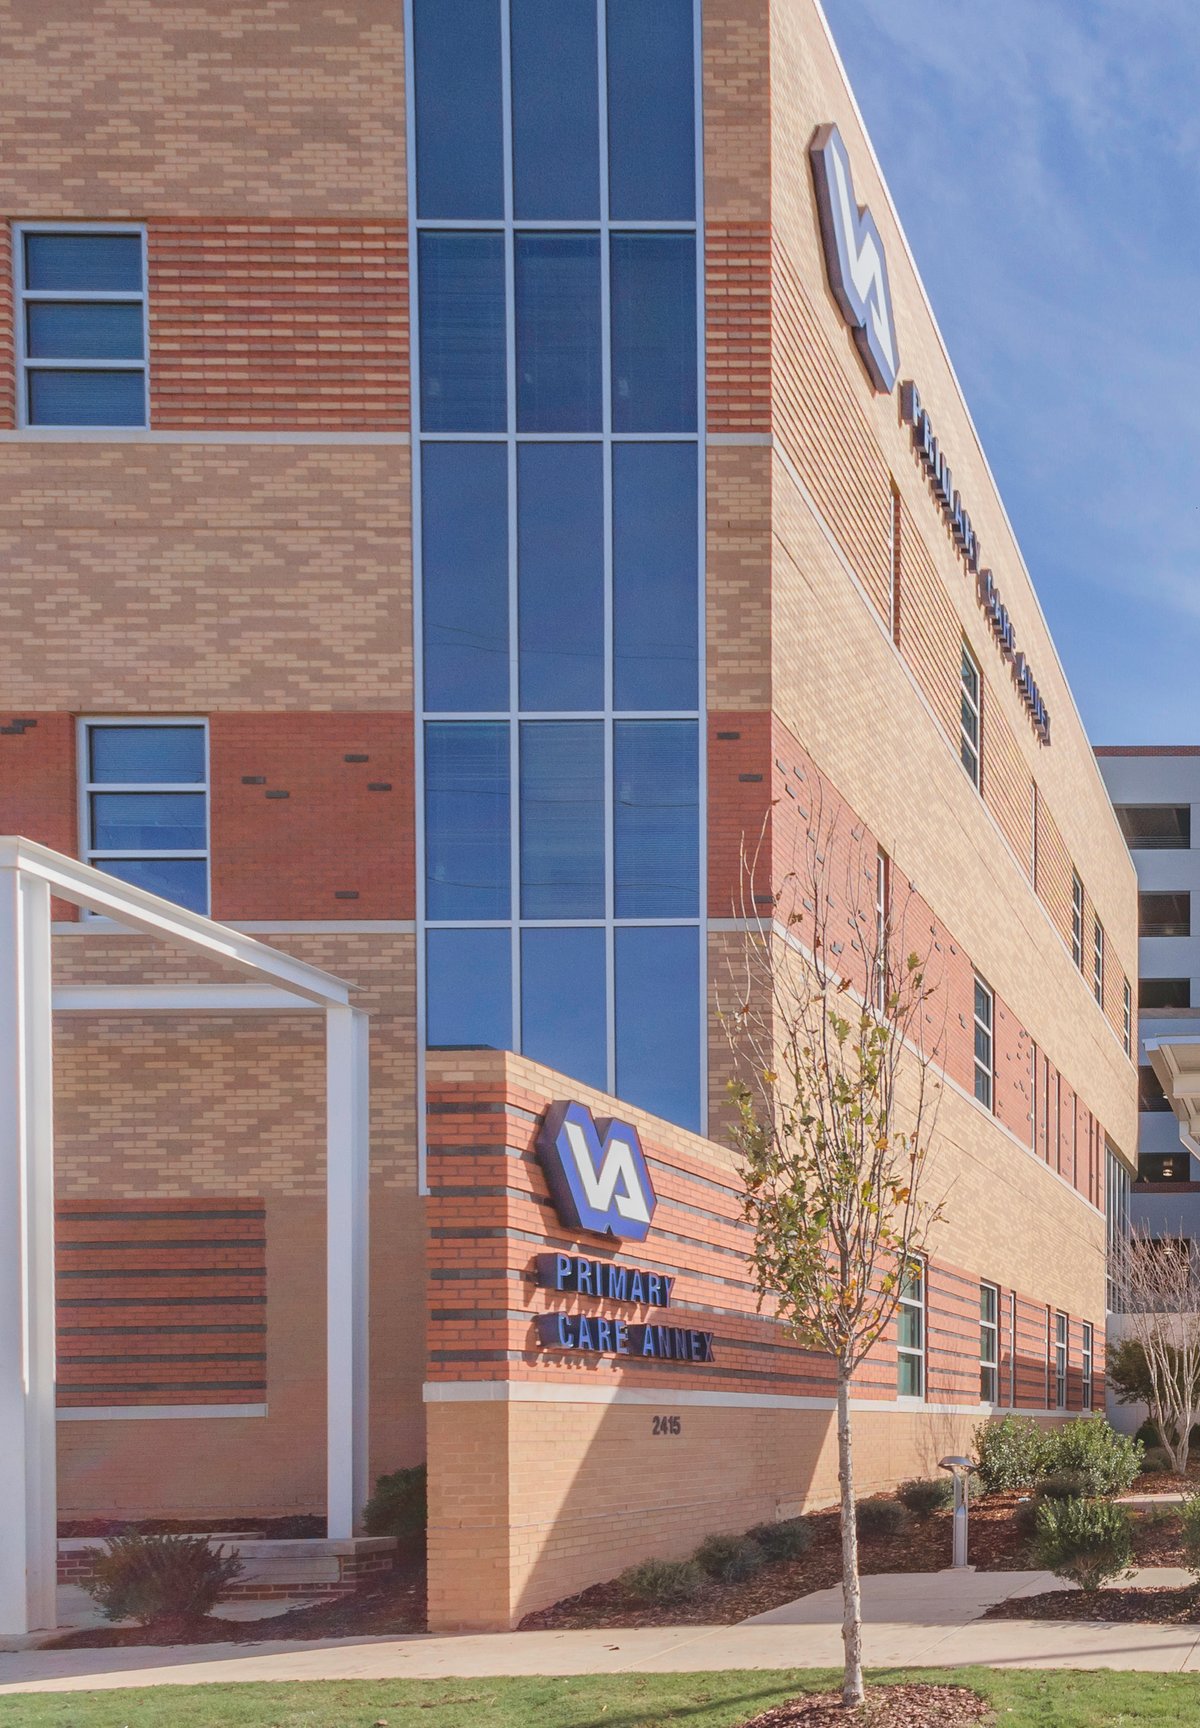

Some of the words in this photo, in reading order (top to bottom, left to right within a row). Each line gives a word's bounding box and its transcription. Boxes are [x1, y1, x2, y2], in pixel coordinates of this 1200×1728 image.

[563, 1120, 651, 1224] VA
[555, 1252, 676, 1309] PRIMARY
[556, 1311, 630, 1355] CARE
[642, 1323, 716, 1363] ANNEX
[651, 1415, 682, 1436] 2415
